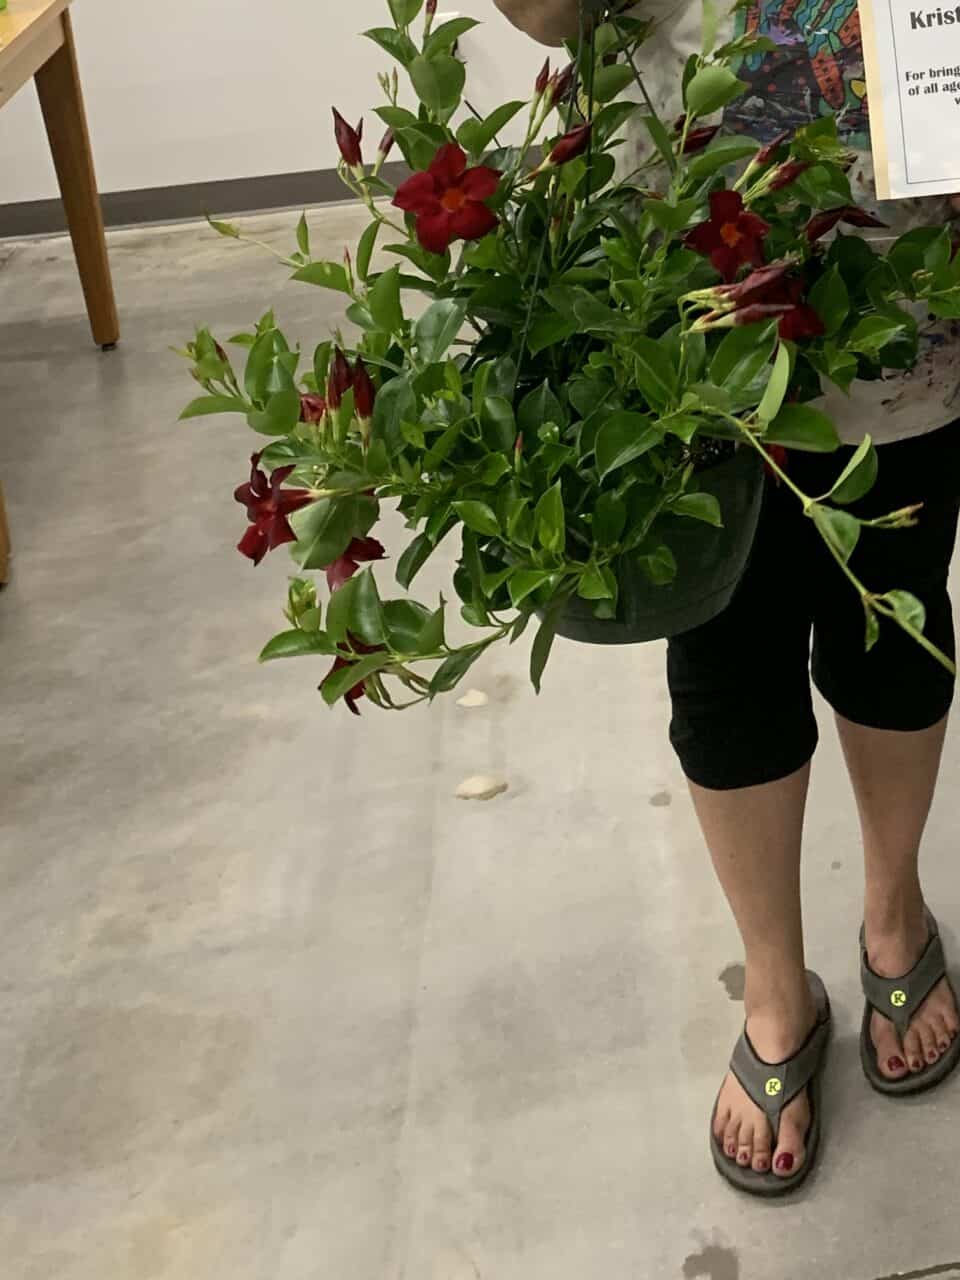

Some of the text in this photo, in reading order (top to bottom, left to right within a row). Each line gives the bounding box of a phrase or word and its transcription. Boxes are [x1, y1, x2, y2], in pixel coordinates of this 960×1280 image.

[905, 70, 926, 82] For
[908, 86, 921, 96] of
[924, 83, 939, 94] all
